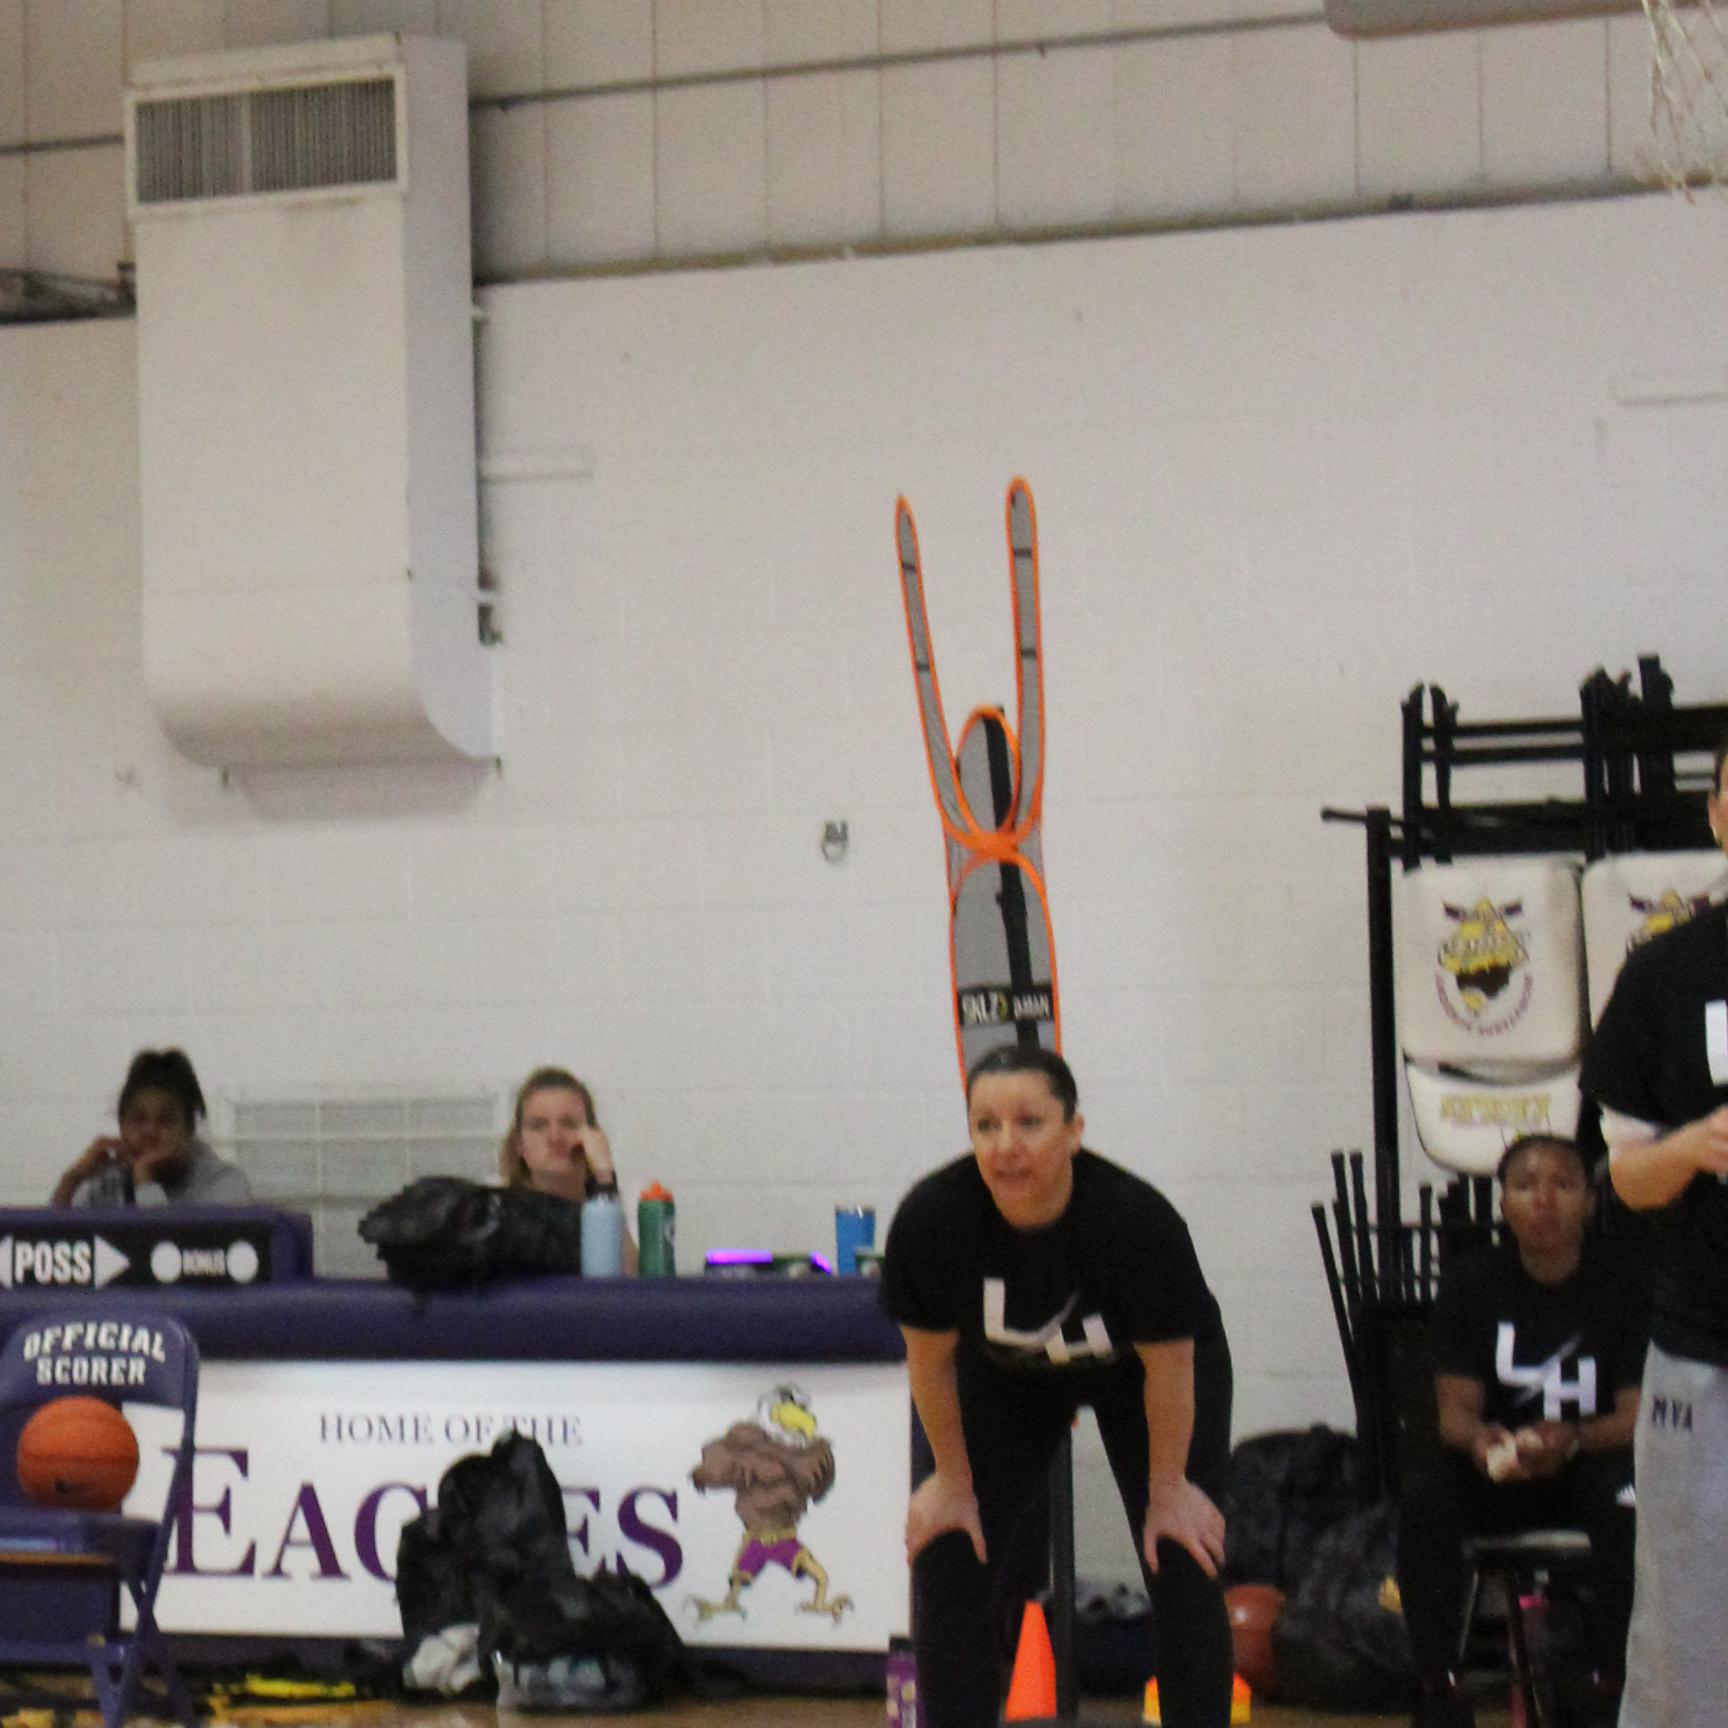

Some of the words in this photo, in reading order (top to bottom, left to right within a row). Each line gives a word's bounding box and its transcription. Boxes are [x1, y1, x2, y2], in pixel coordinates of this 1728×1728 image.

[14, 1241, 92, 1285] POSS
[23, 1322, 165, 1363] OFFICIAL
[36, 1357, 146, 1386] SCORER
[319, 1414, 433, 1444] HOME
[443, 1414, 493, 1444] OF
[502, 1414, 584, 1446] THE
